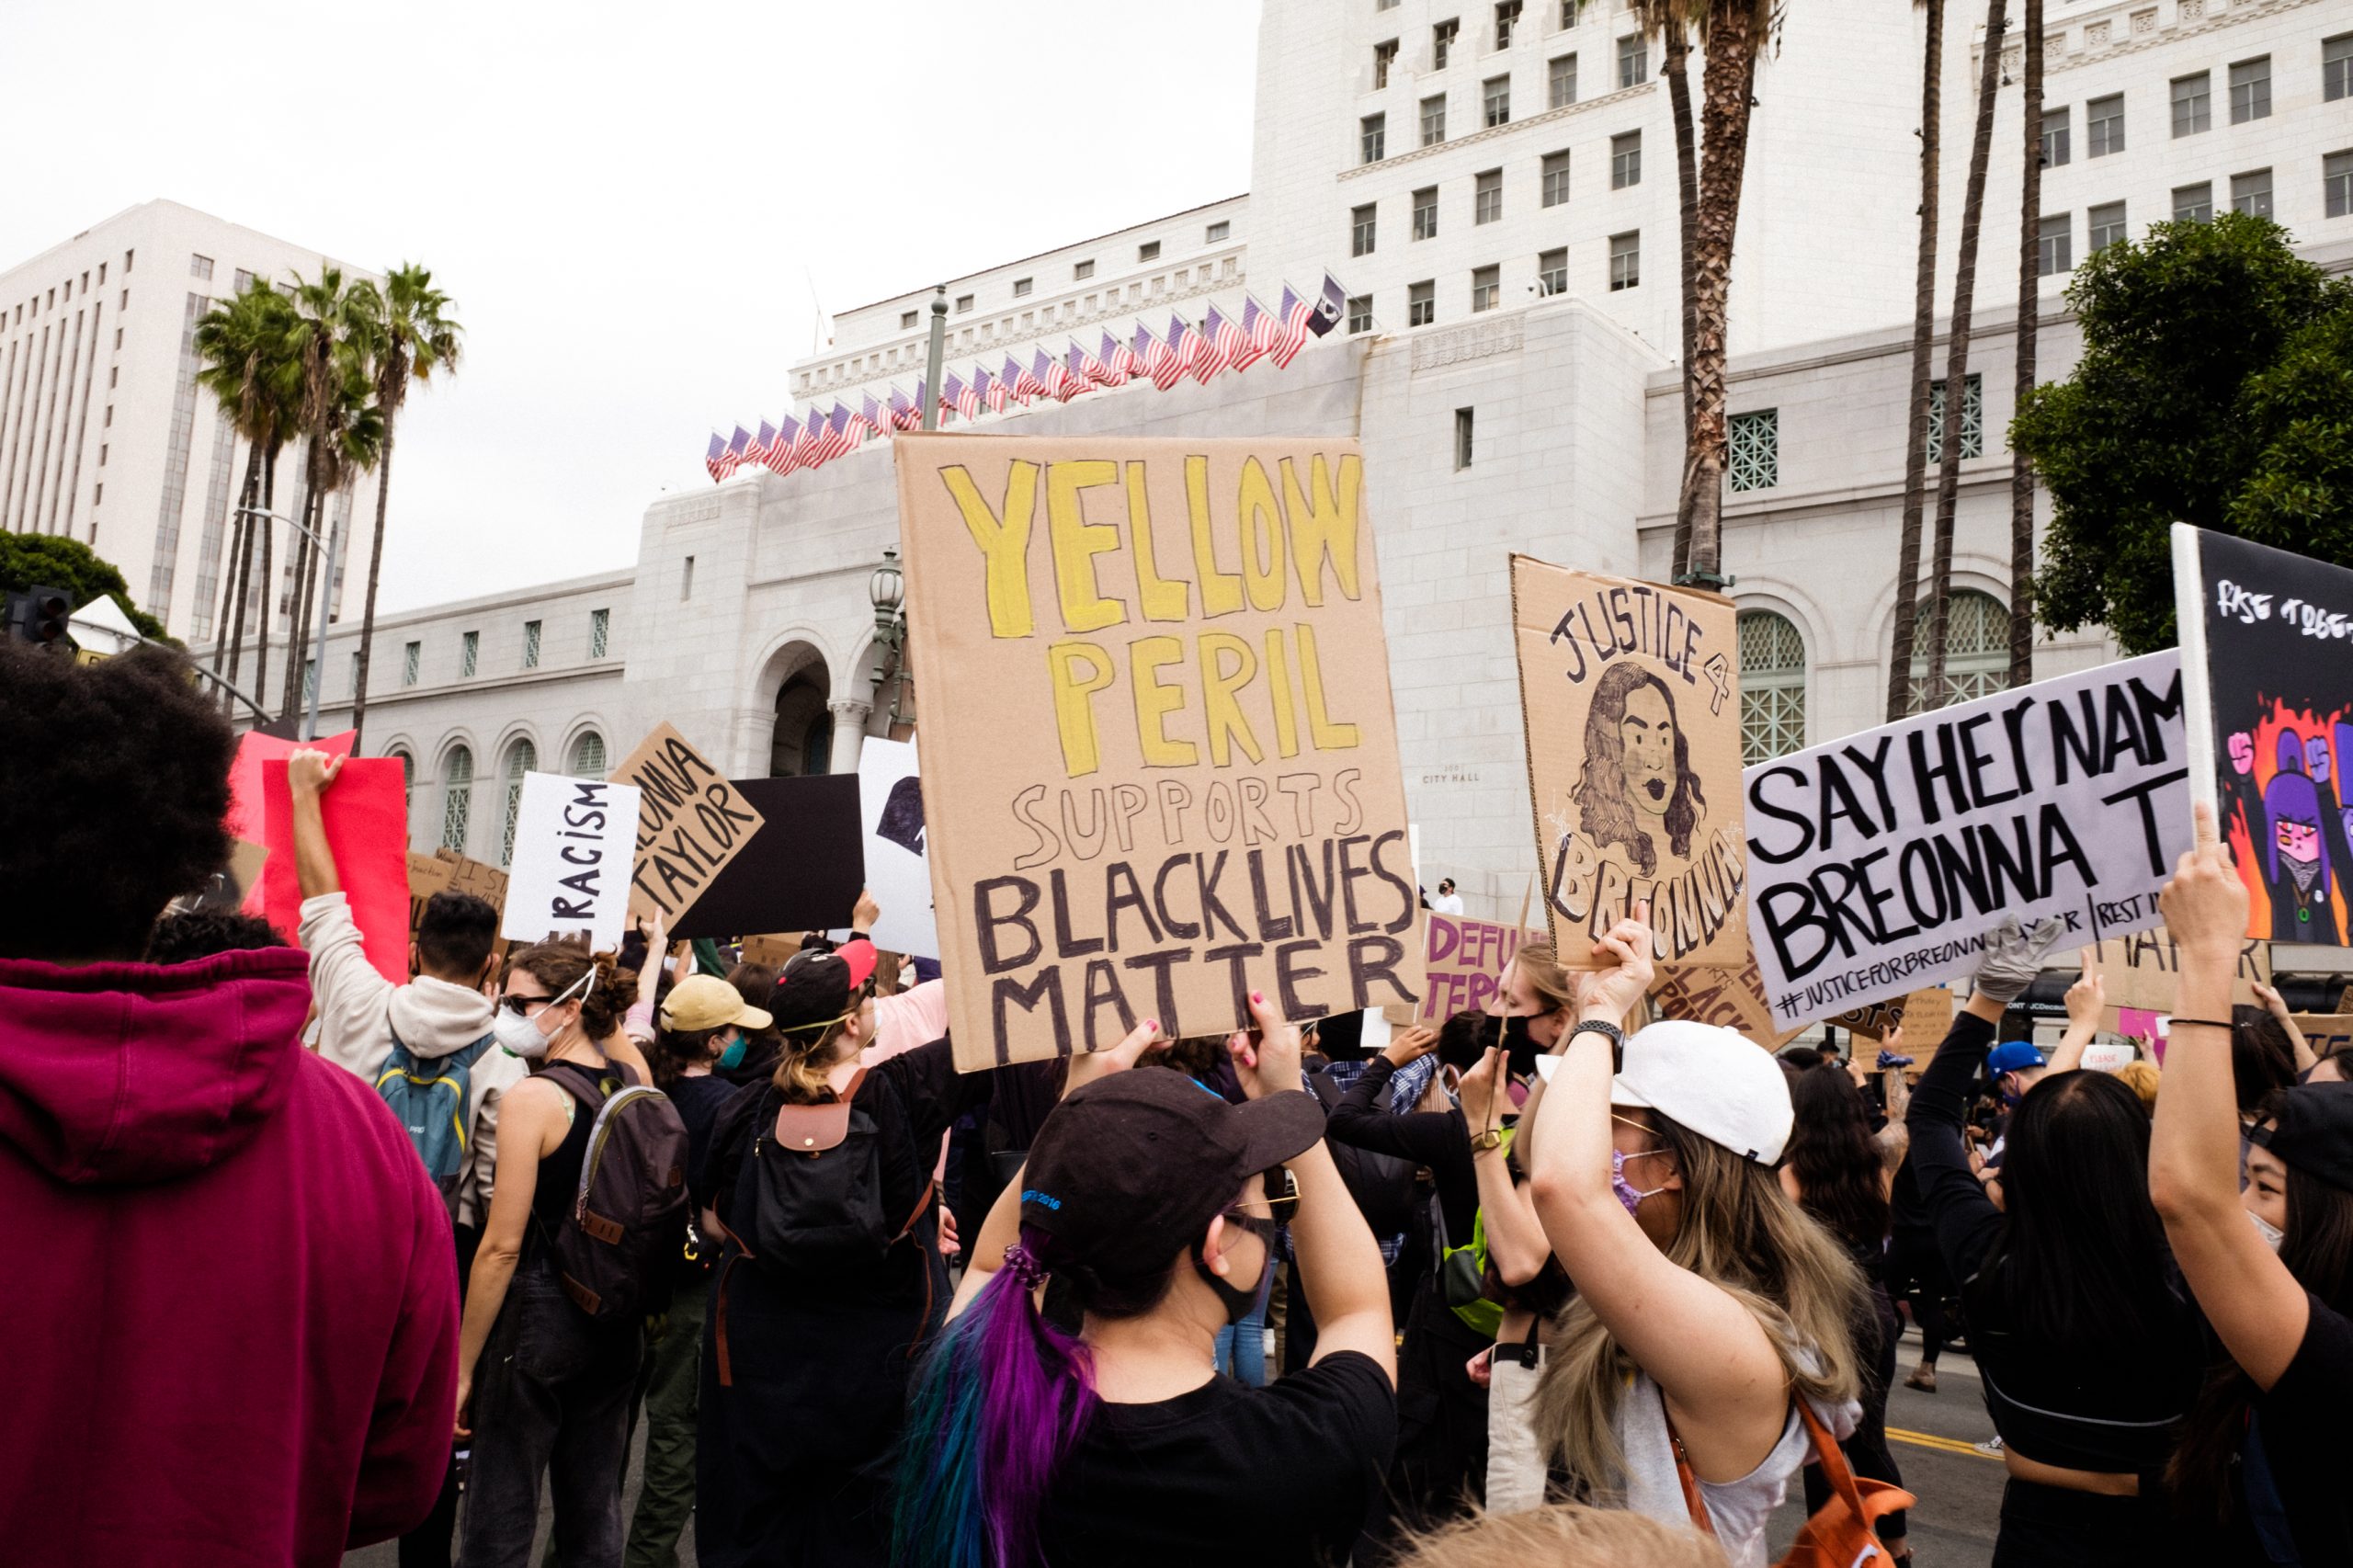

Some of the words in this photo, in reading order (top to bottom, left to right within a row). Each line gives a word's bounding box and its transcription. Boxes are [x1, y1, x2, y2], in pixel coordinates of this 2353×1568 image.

[938, 453, 1364, 638] YELLOW
[2217, 579, 2274, 624] RISE
[1048, 623, 1359, 778] PERIL
[1550, 586, 1703, 686] JUSTICE
[1011, 768, 1363, 870] SUPPORTS
[1423, 775, 1447, 784] CITY
[1452, 773, 1479, 782] HALL
[1746, 736, 1897, 864] SAY
[2047, 668, 2186, 786] NAM
[631, 783, 755, 916] TAYLOR
[974, 849, 1248, 974] BLACK
[1247, 830, 1415, 944] LIVES
[1756, 803, 2098, 983] BREONNA
[2100, 767, 2188, 877] T
[2097, 894, 2143, 928] REST
[993, 936, 1420, 1066] MATTER
[1428, 915, 1520, 972] DEFU
